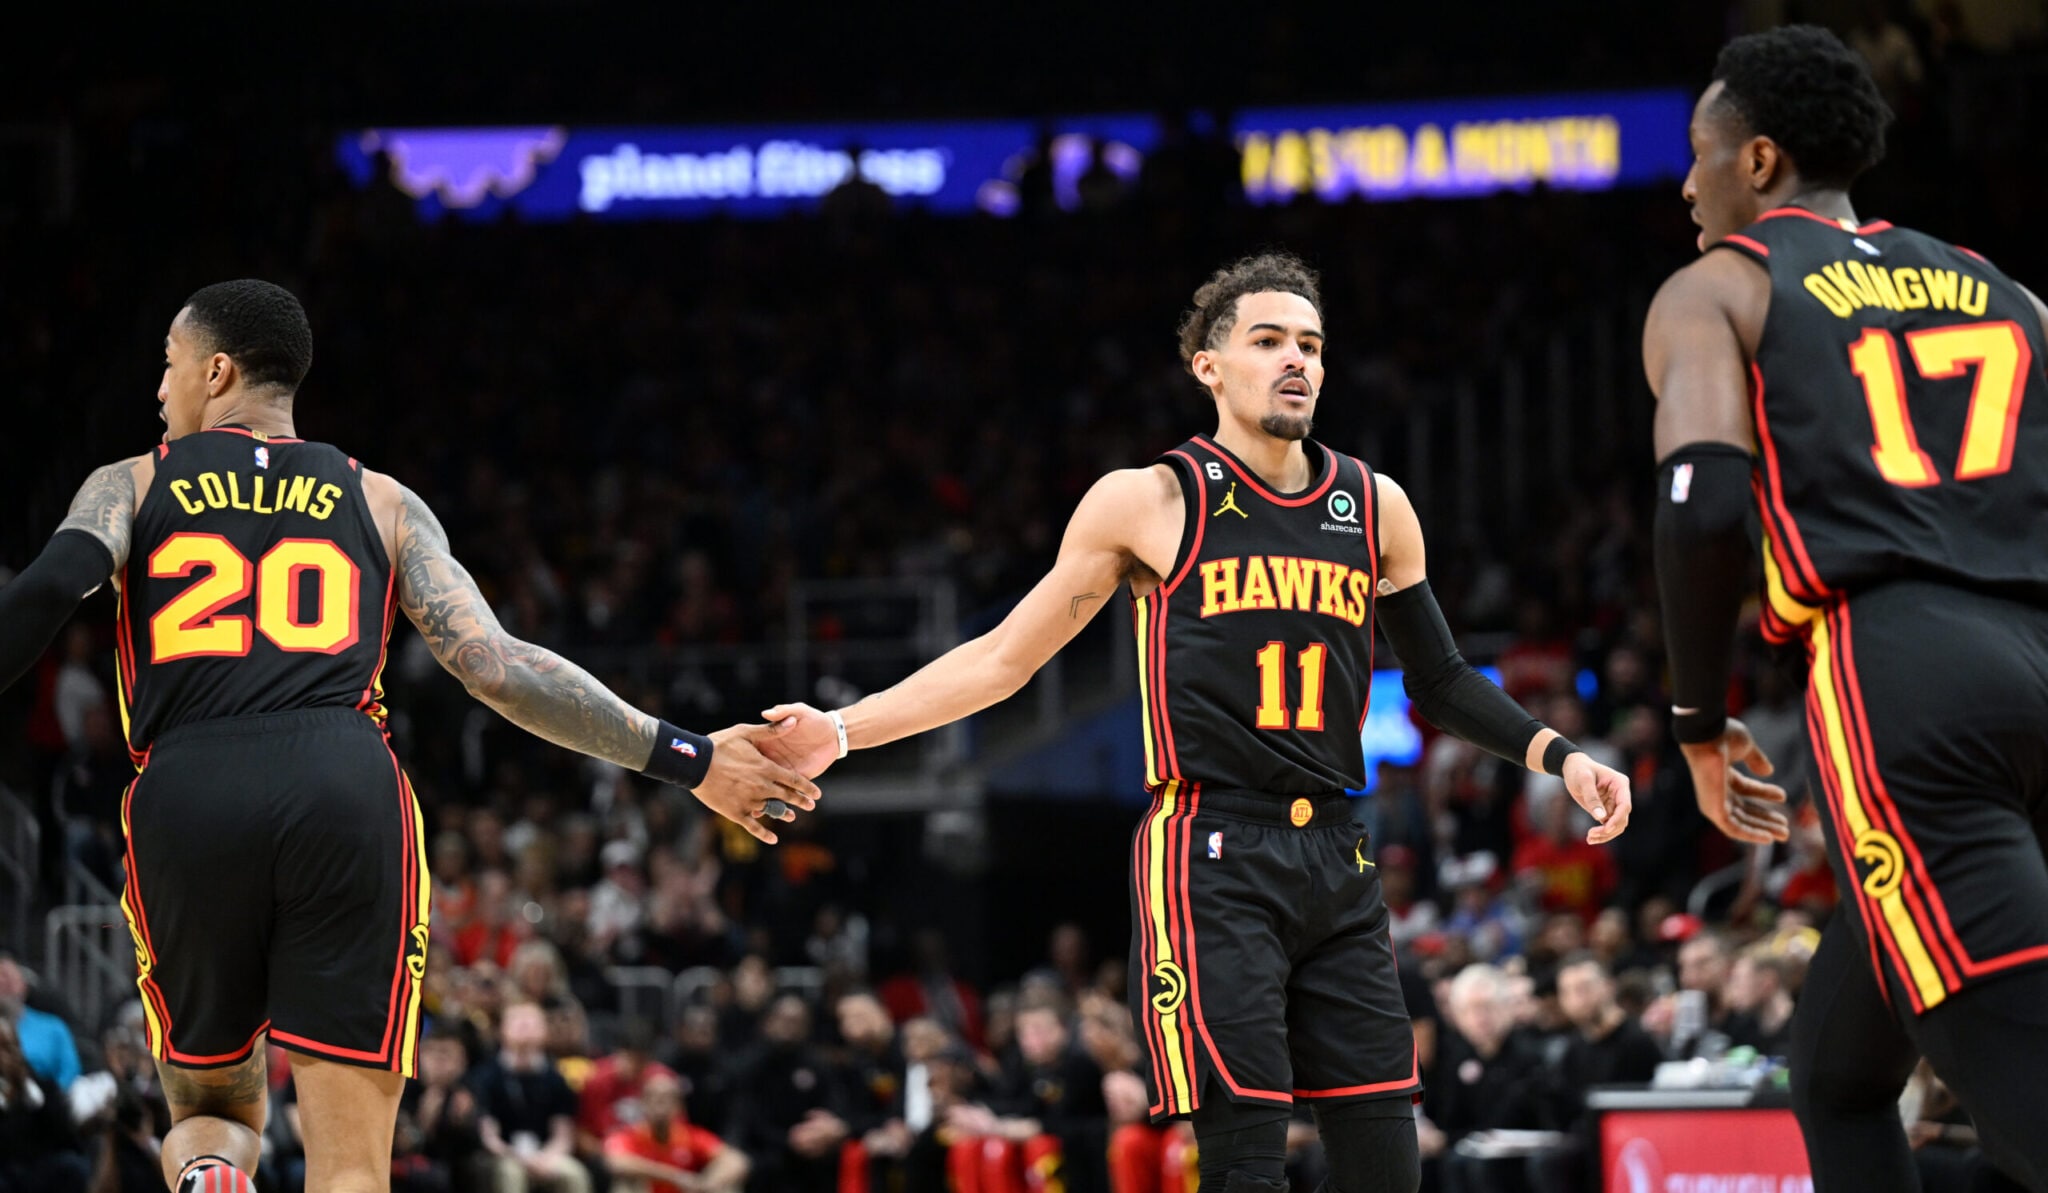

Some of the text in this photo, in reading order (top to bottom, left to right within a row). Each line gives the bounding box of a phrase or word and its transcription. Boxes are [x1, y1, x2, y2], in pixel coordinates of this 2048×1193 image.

[580, 143, 753, 212] planet
[1803, 260, 1989, 319] OKONGWU
[1848, 320, 2032, 489] 17
[170, 470, 343, 520] COLLINS
[1205, 461, 1224, 480] 6
[1320, 521, 1363, 534] sharecare
[148, 531, 360, 664] 20
[1199, 555, 1370, 627] HAWKS
[1256, 640, 1327, 731] 11
